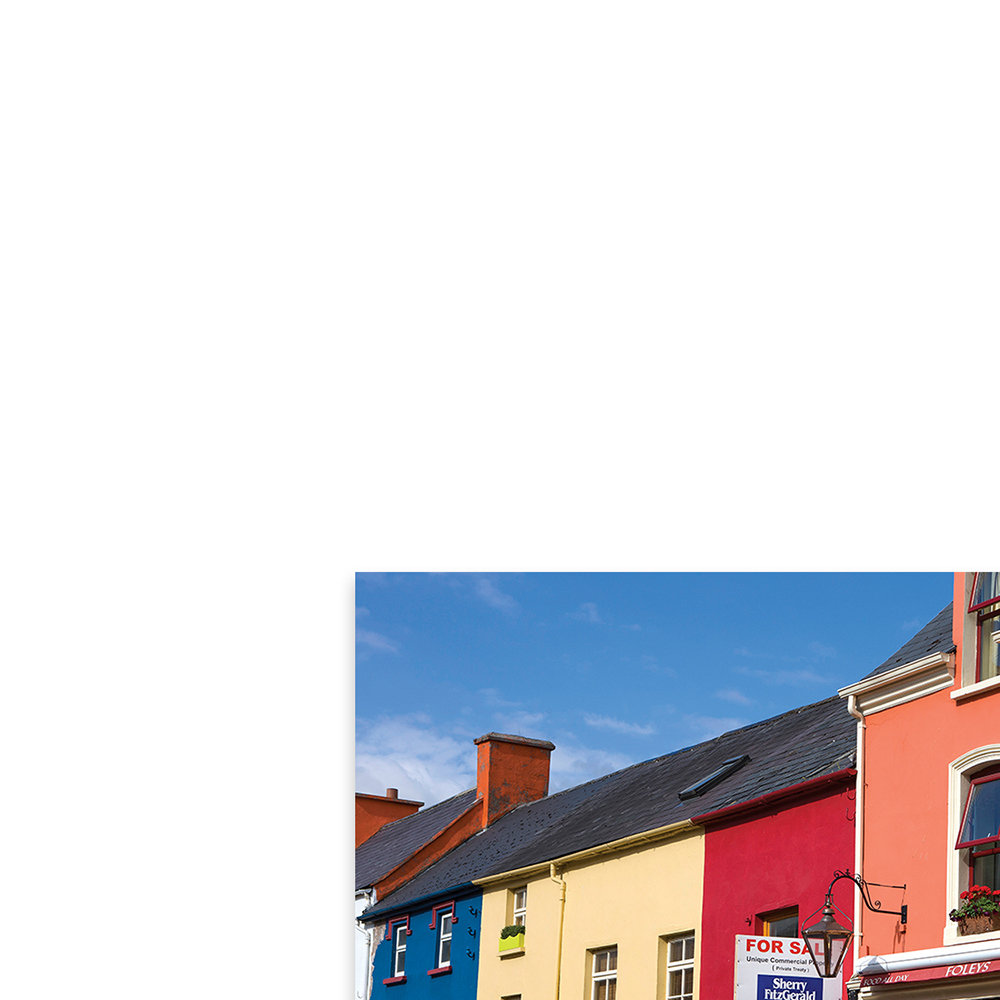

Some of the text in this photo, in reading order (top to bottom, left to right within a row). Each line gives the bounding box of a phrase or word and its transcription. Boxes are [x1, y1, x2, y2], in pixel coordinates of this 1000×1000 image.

[746, 938, 829, 956] FOR SAL
[746, 955, 769, 964] Unique
[769, 957, 807, 965] Commercial
[944, 961, 992, 978] FOLEYS
[773, 977, 807, 991] Sherry
[894, 974, 910, 983] DAY
